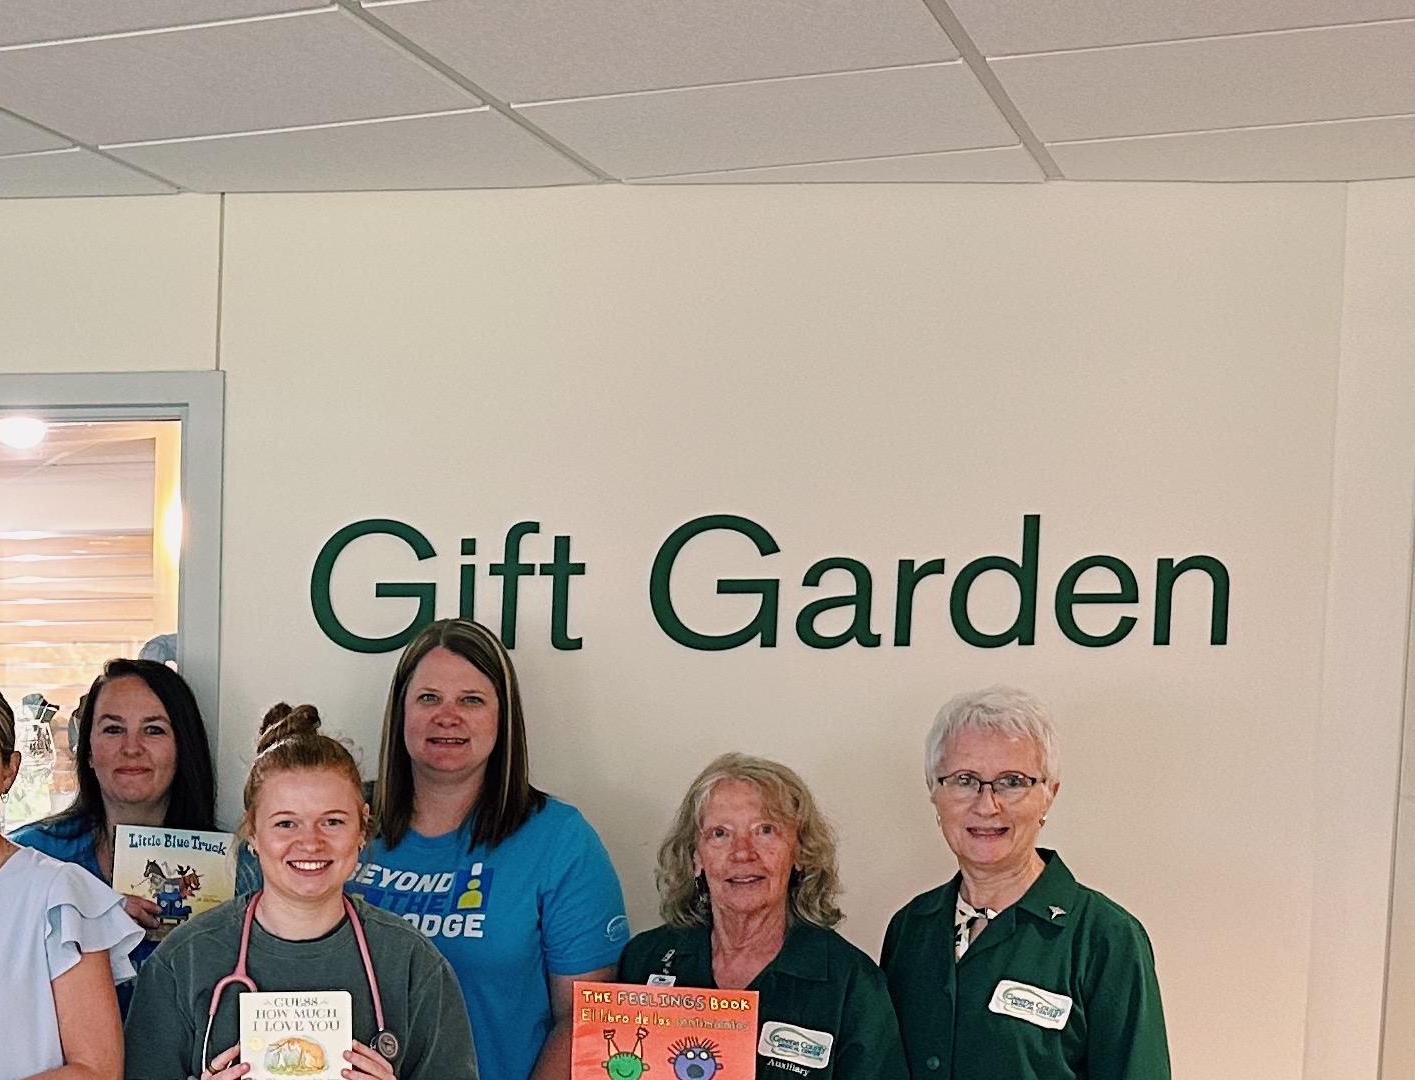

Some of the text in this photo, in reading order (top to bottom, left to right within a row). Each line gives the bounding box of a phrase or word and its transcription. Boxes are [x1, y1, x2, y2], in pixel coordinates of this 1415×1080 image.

[310, 514, 1231, 653] Gift Garden
[128, 833, 227, 856] Little Blue Truck
[387, 892, 448, 913] THE
[274, 996, 318, 1008] GUESS
[582, 990, 612, 1004] THE
[617, 990, 705, 1011] FEELINGS
[256, 1008, 337, 1020] HOW MUCH
[581, 1008, 595, 1023] El
[600, 1008, 630, 1024] libro
[634, 1012, 649, 1026] de
[653, 1012, 671, 1027] los
[253, 1020, 340, 1032] I LOVE YOU
